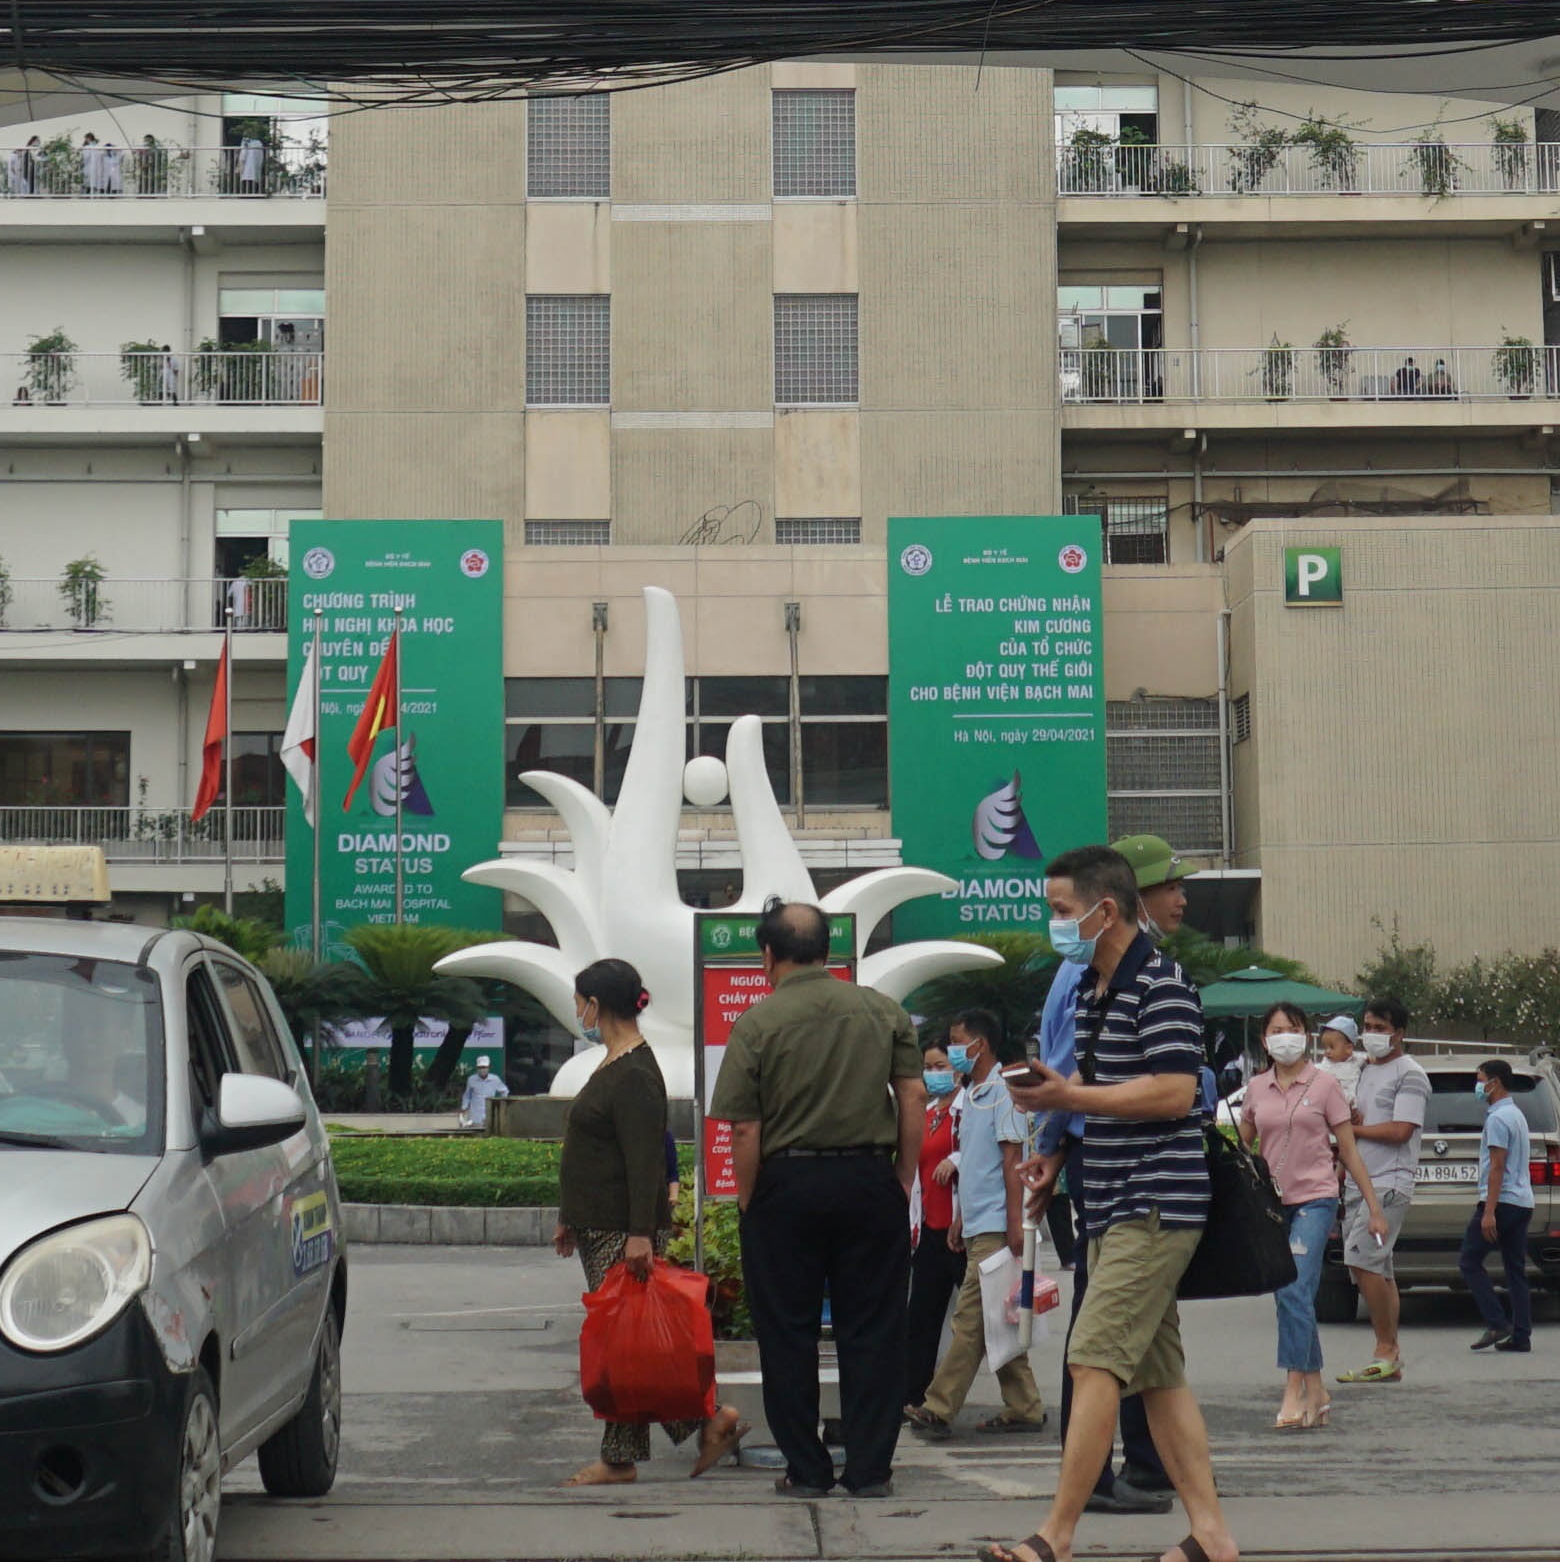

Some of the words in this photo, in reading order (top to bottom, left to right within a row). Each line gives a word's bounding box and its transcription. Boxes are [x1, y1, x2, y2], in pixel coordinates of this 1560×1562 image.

[1298, 554, 1328, 596] P
[303, 591, 364, 608] CHƯƠNG
[370, 590, 416, 608] TRÌNH
[935, 593, 952, 613] LỄ
[958, 598, 993, 612] TRAO
[999, 595, 1047, 612] CHỨNG
[1052, 595, 1091, 614] NHẬN
[303, 618, 329, 632] HI
[334, 618, 371, 636] NGHỊ
[423, 617, 454, 635] HỌC
[1014, 620, 1040, 633] KIM
[1045, 618, 1092, 633] CƯƠNG
[303, 638, 363, 657] CUYÊN
[999, 637, 1027, 656] CỦA
[1032, 635, 1050, 656] TỔ
[1055, 638, 1092, 656] CHỨC
[966, 661, 993, 680] ĐỘT
[1032, 659, 1059, 677] THẾ
[1064, 660, 1093, 677] GIỚI
[910, 687, 938, 701] CHO
[943, 683, 981, 702] BỆNH
[987, 683, 1019, 702] VIỆN
[1025, 685, 1062, 702] BẠCH
[1067, 685, 1093, 699] MAI
[338, 834, 450, 852] DIAMOND
[354, 884, 414, 894] AWARDD
[416, 884, 433, 894] TO
[336, 898, 368, 909] BACH
[402, 898, 451, 909] OSPITAL
[960, 904, 1042, 922] STATUS
